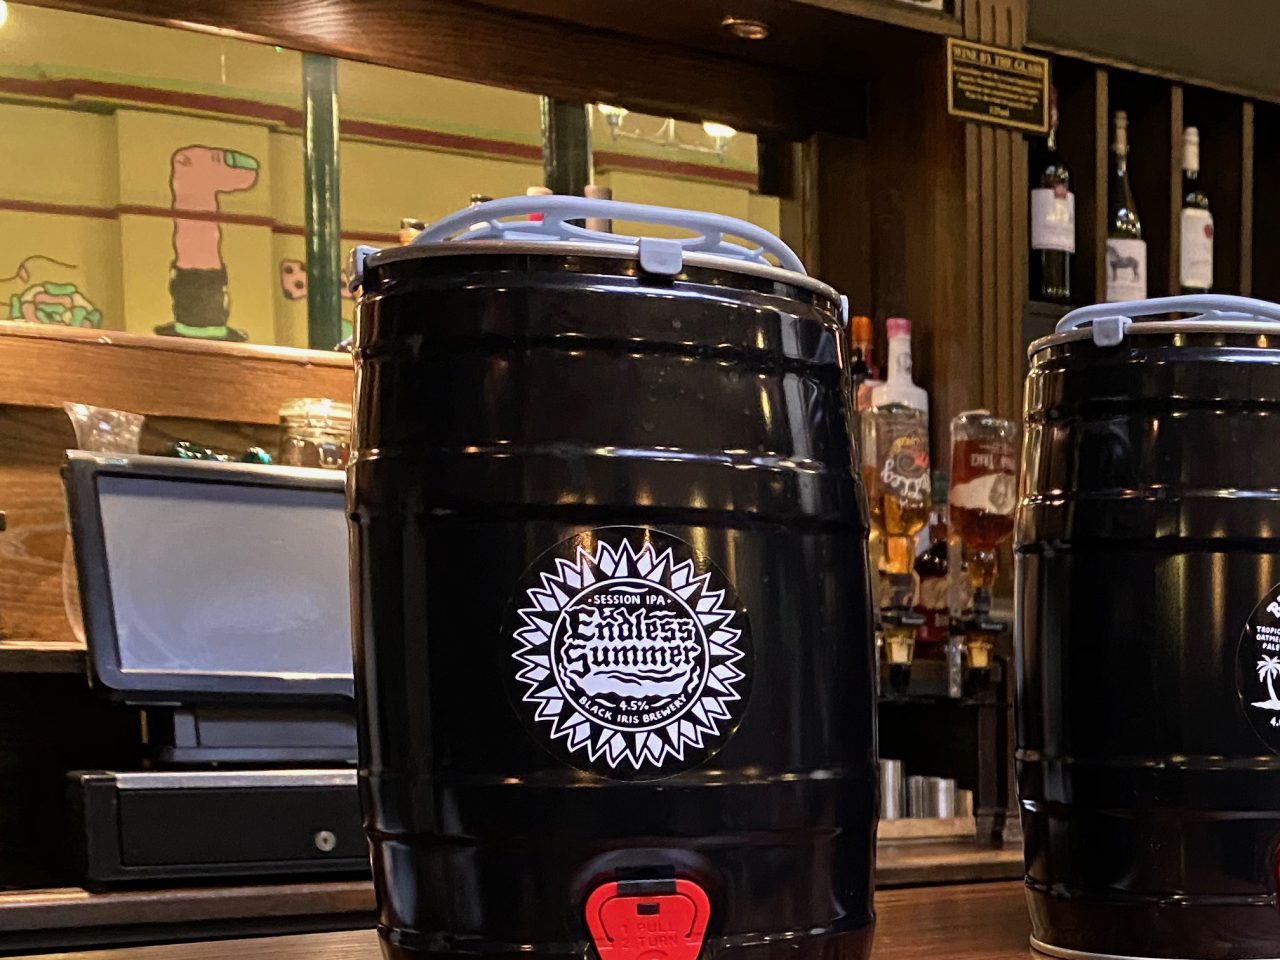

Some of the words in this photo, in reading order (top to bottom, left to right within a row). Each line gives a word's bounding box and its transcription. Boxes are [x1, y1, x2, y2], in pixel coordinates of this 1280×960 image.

[593, 594, 641, 605] SESSION
[645, 595, 666, 605] IPA
[563, 605, 695, 643] Endless
[1262, 642, 1280, 652] PALE
[562, 642, 701, 679] Summer
[579, 695, 612, 720] BLACK
[616, 714, 640, 724] IRIS
[642, 694, 687, 723] BREWERY
[619, 700, 650, 712] 4.5%
